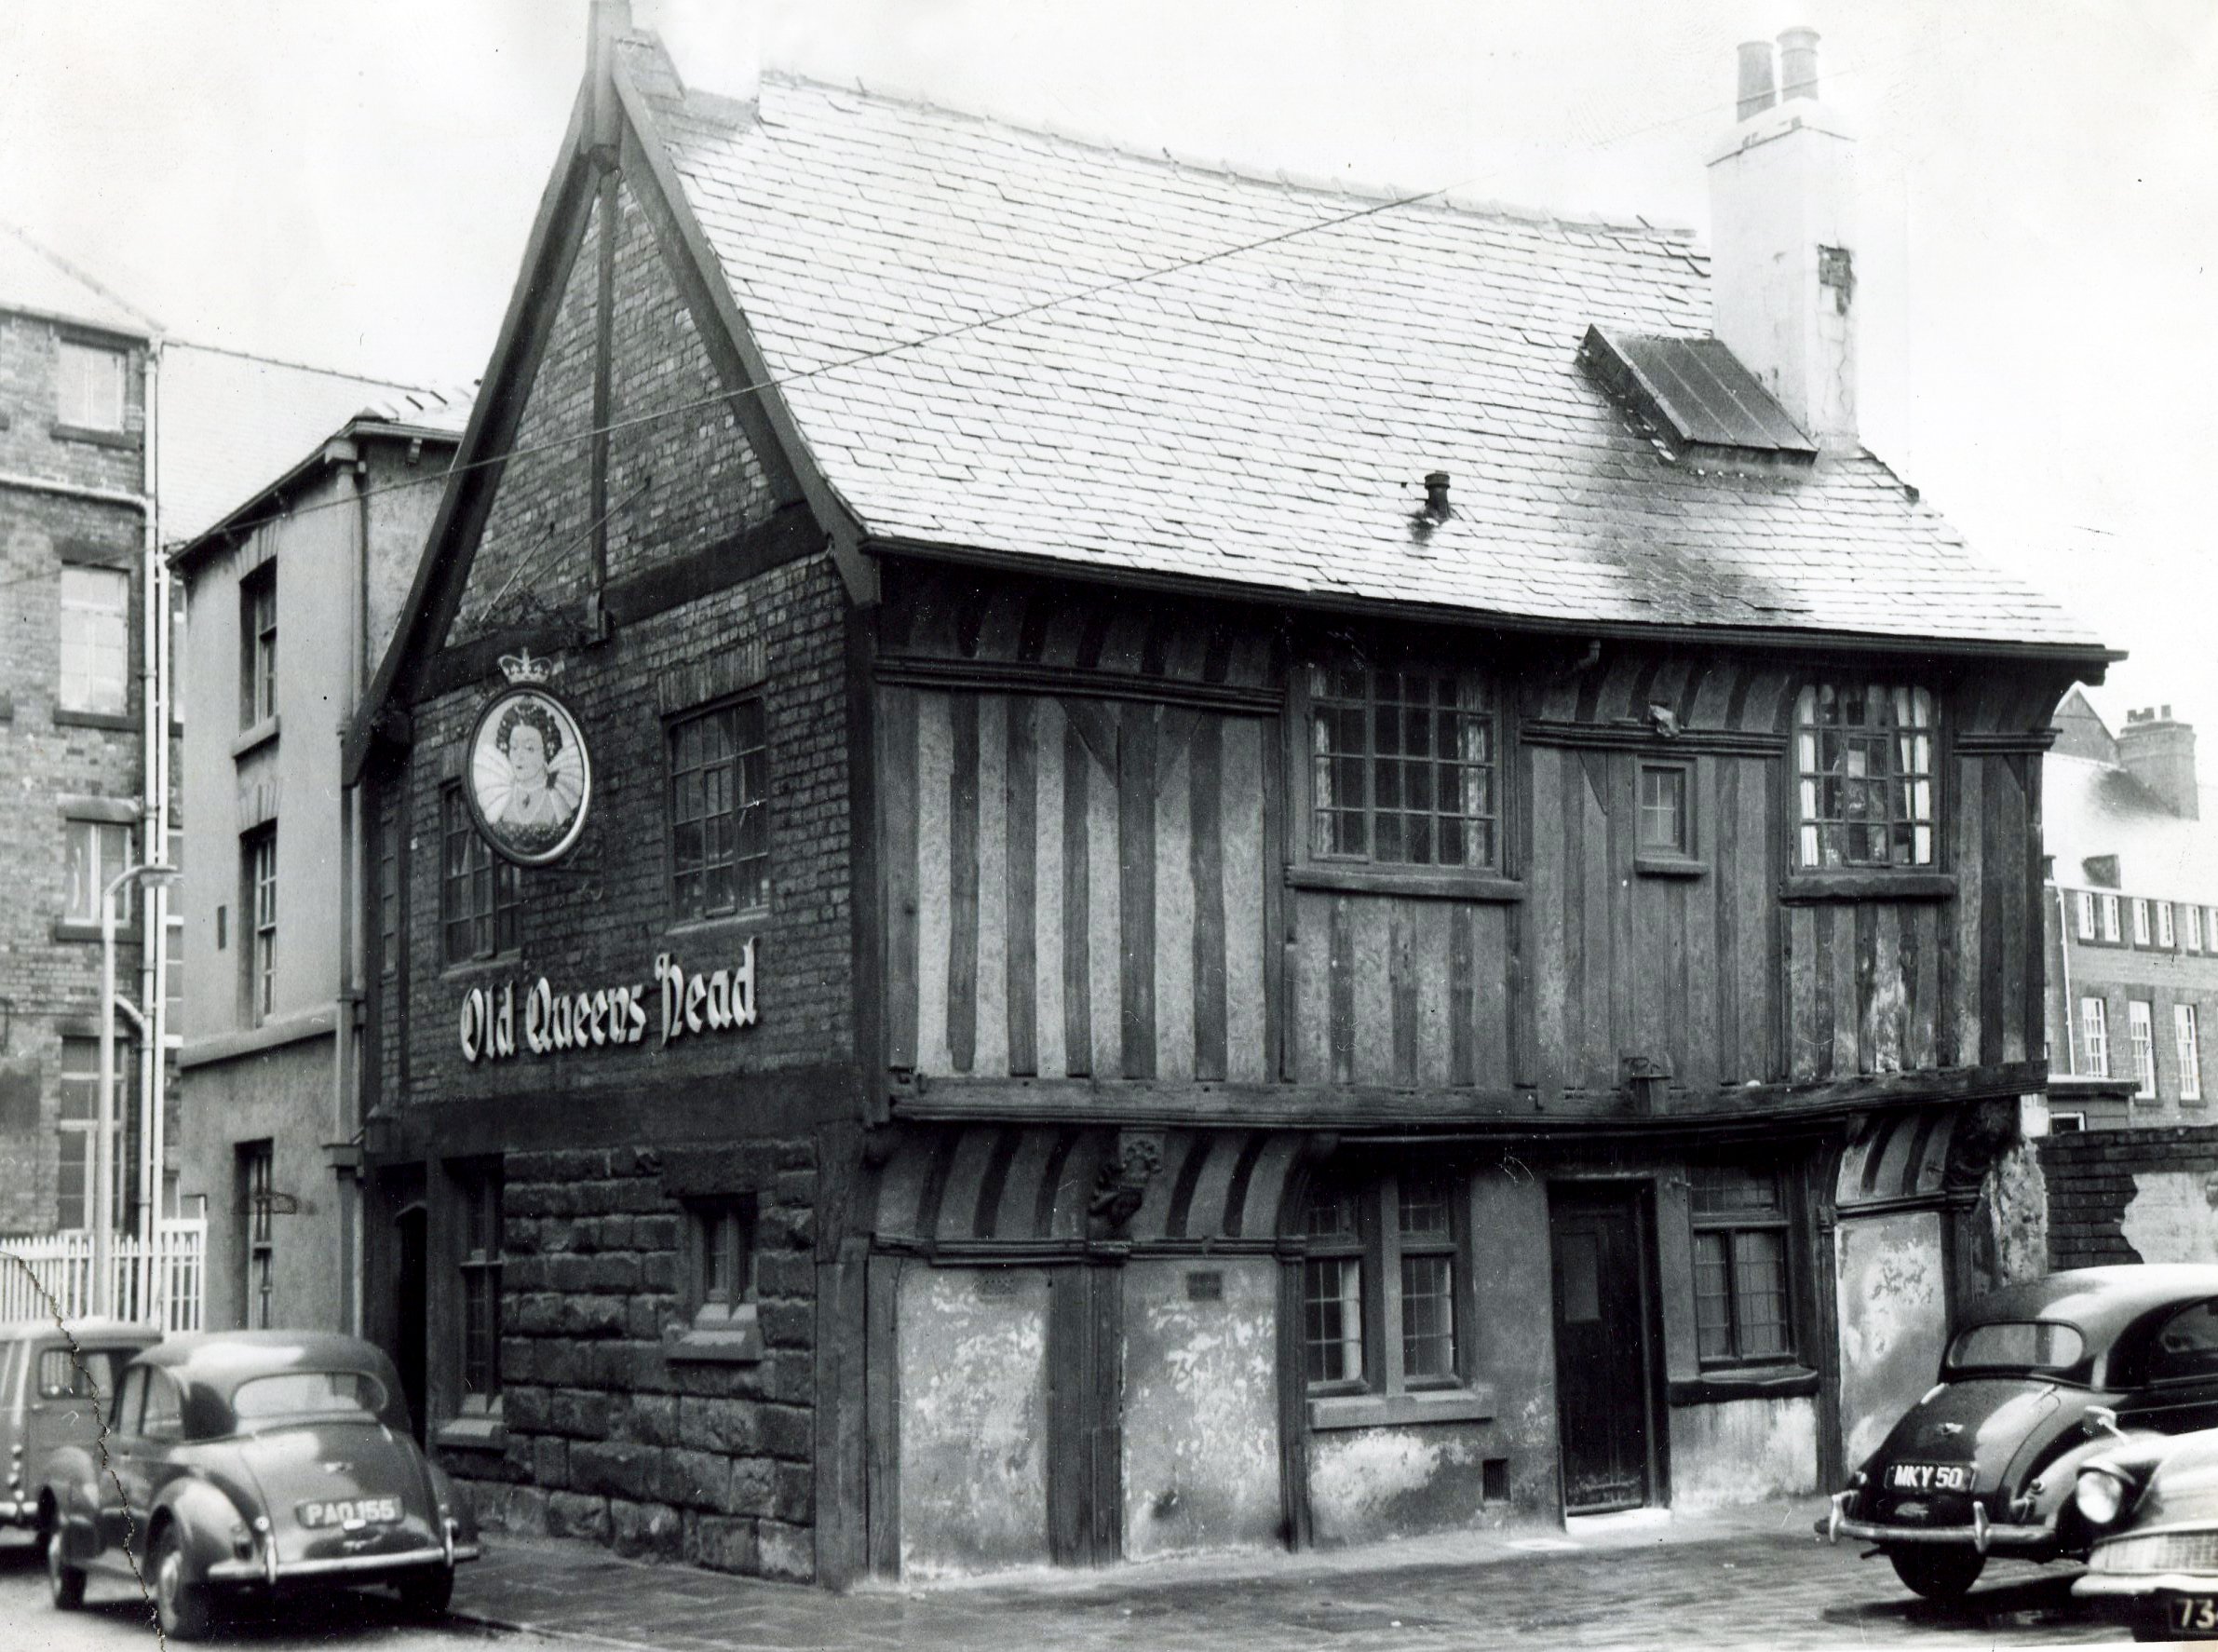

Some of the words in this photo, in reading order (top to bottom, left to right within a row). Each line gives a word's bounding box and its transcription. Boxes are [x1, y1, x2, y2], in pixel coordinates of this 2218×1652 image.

[460, 982, 514, 1063] Old
[525, 977, 647, 1053] Queens
[1894, 1465, 1934, 1488] MKY
[1935, 1467, 1964, 1489] 50
[2176, 1598, 2218, 1629] 73
